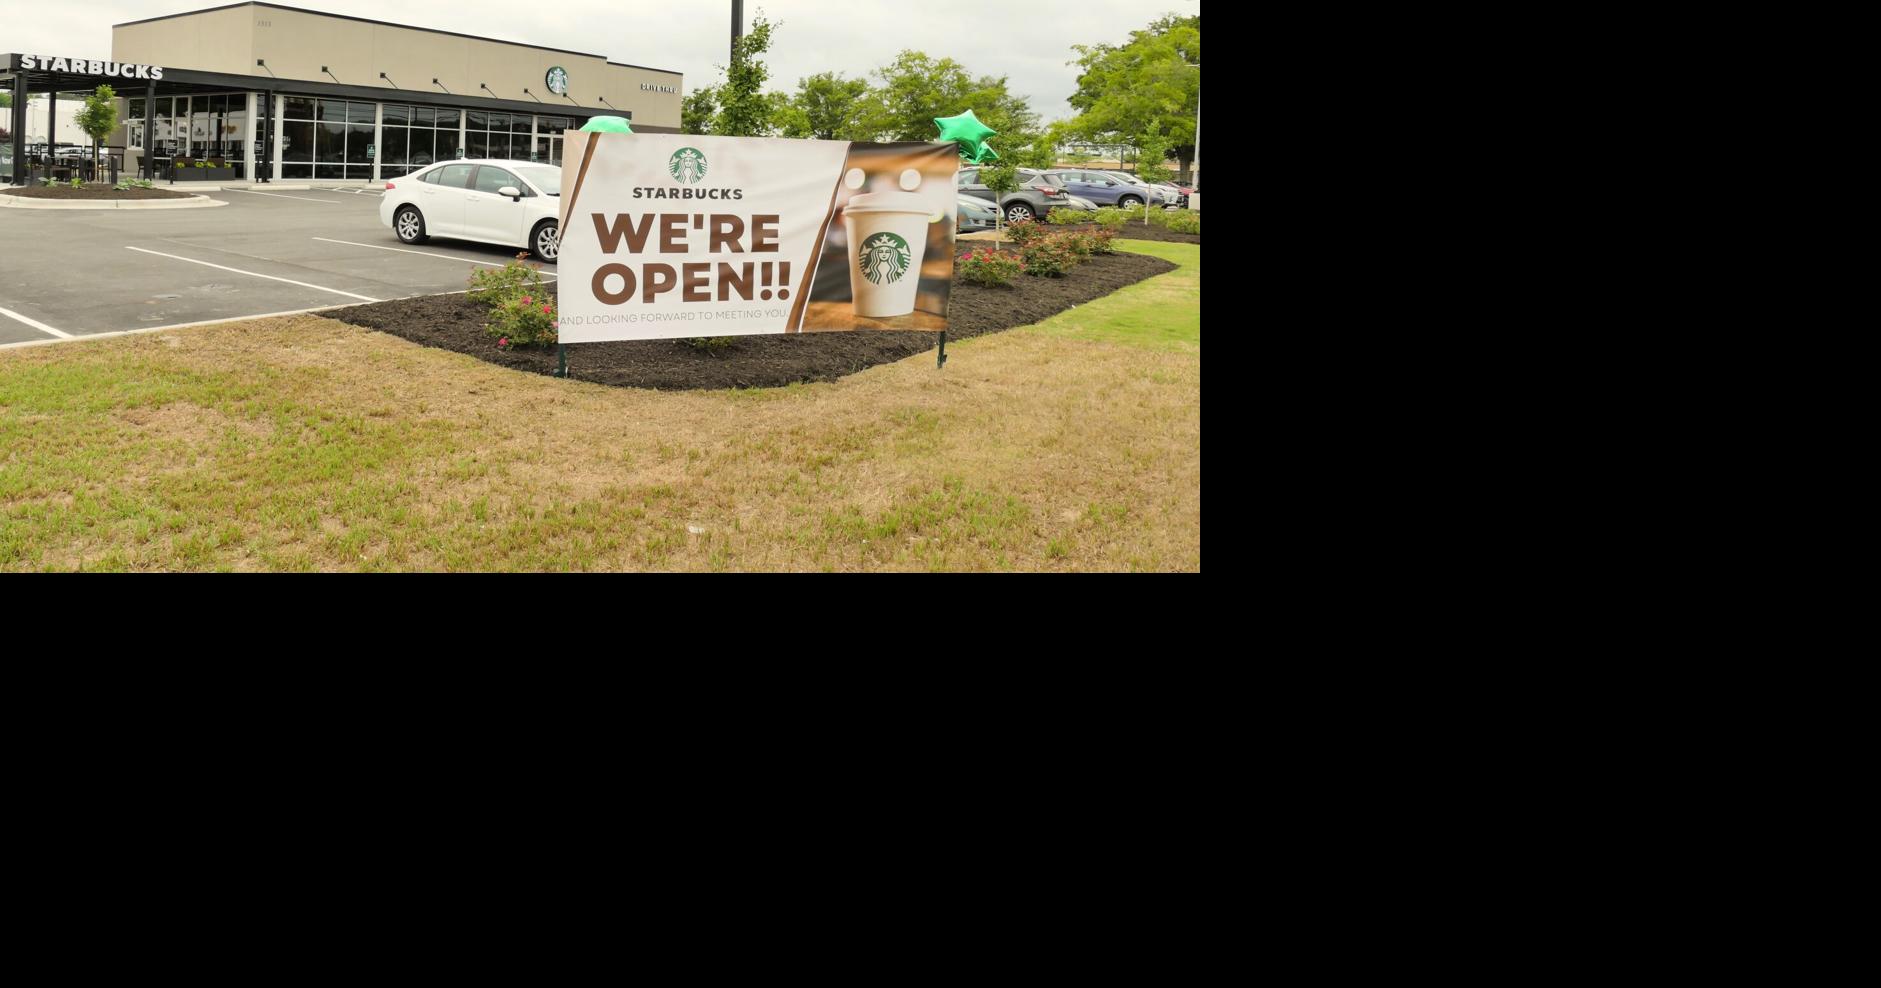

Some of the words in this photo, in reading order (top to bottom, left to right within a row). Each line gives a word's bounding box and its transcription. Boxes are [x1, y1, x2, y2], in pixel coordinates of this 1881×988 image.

[21, 54, 163, 80] STARBUCKS
[632, 187, 743, 200] STARBUCKS
[591, 213, 780, 254] WE'RE
[591, 261, 791, 305] OPEN!!
[560, 316, 583, 325] AND
[586, 314, 638, 324] LOOKING
[641, 312, 695, 322] FORWARD
[699, 311, 713, 320] TO
[716, 310, 761, 320] MEETING
